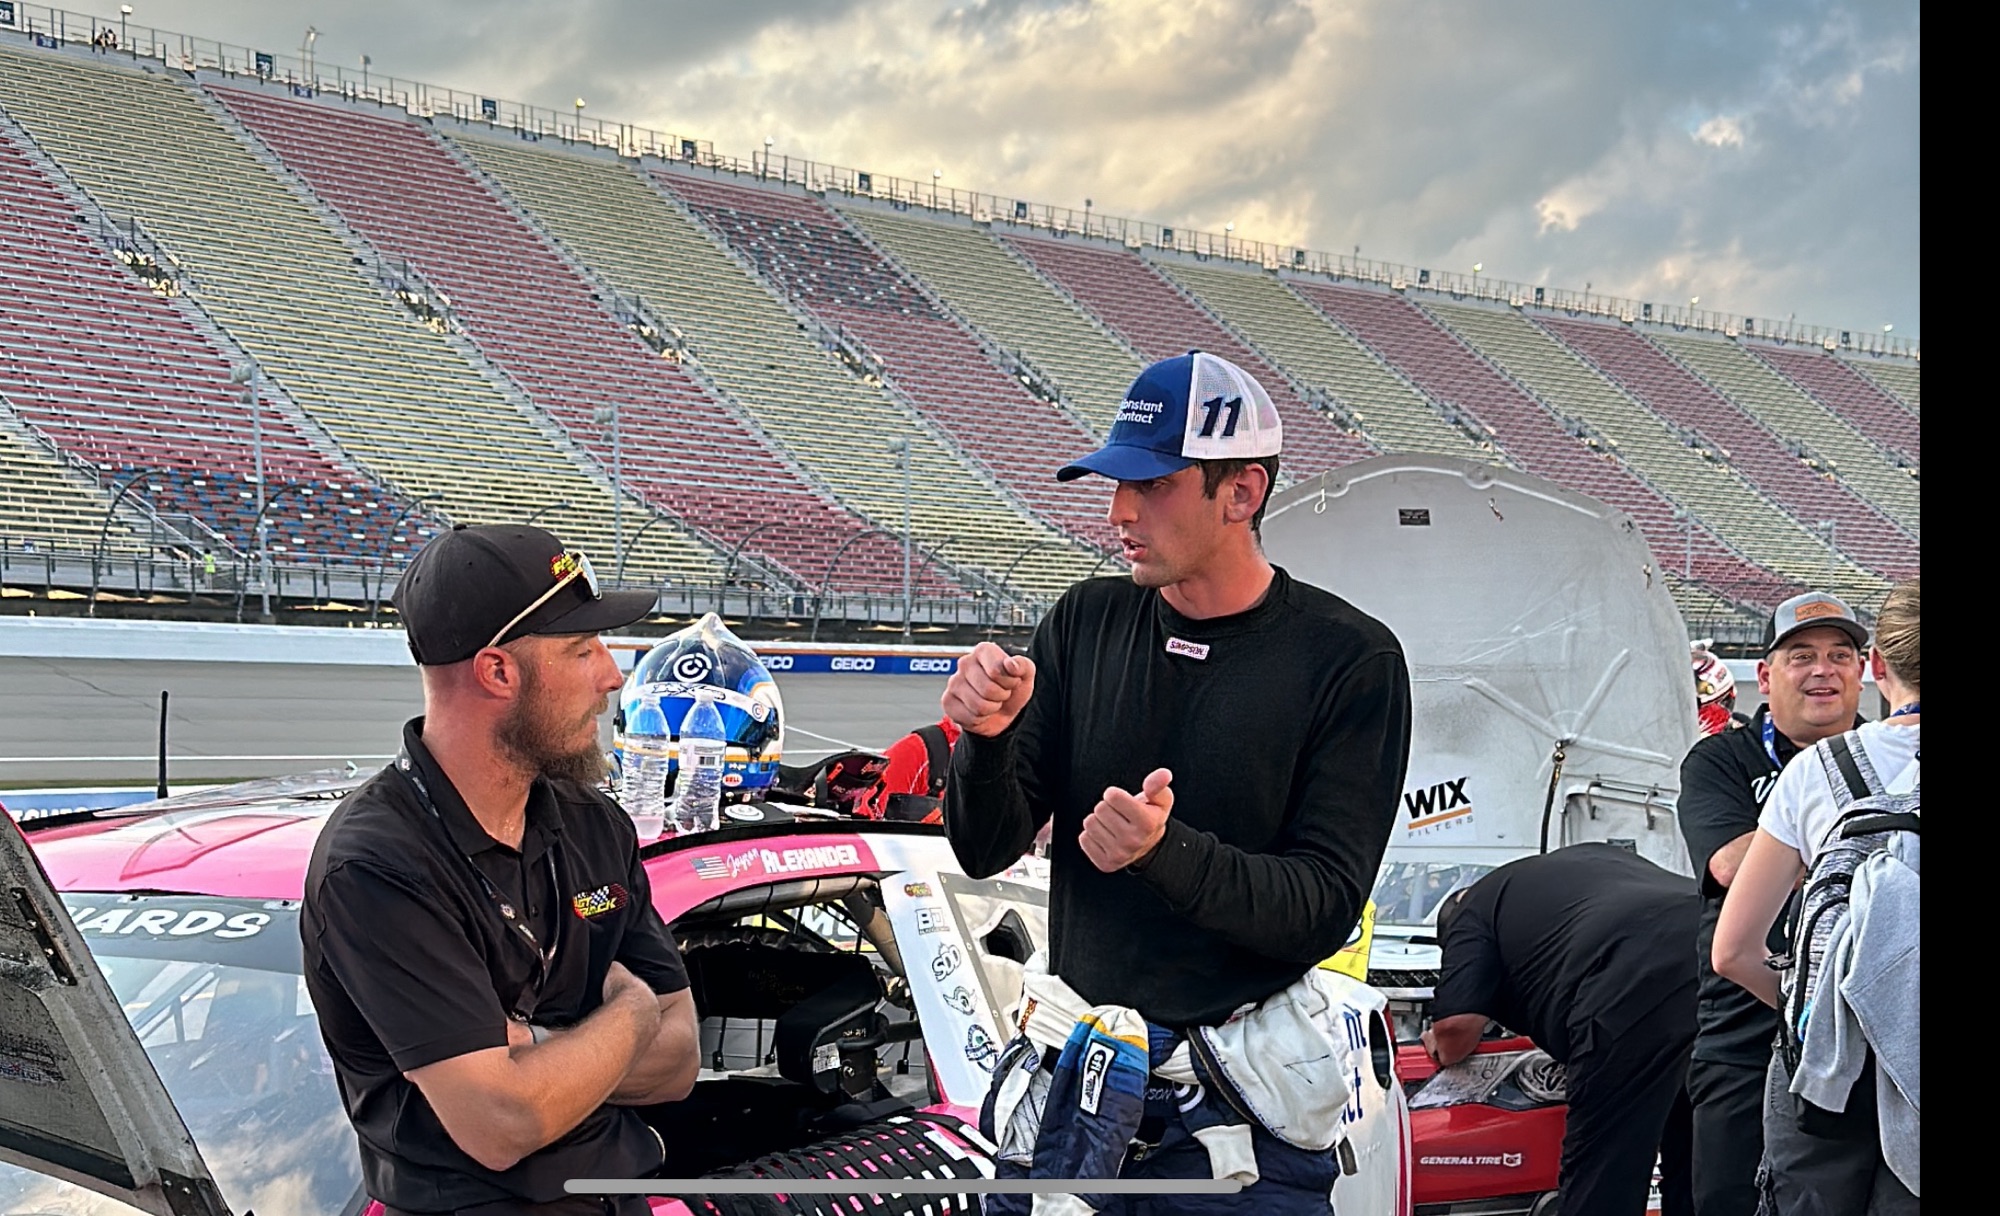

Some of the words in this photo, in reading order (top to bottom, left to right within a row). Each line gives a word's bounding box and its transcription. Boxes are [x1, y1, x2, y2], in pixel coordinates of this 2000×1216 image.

[1199, 397, 1242, 437] 11
[759, 656, 793, 669] EICO
[831, 657, 875, 671] GEICO
[910, 658, 951, 672] GEICO
[1404, 776, 1471, 819] WIX
[1408, 815, 1474, 838] FILTERS
[760, 844, 861, 874] ALEXANDER
[1420, 1156, 1474, 1165] GENERAL
[1475, 1156, 1502, 1165] TIRE
